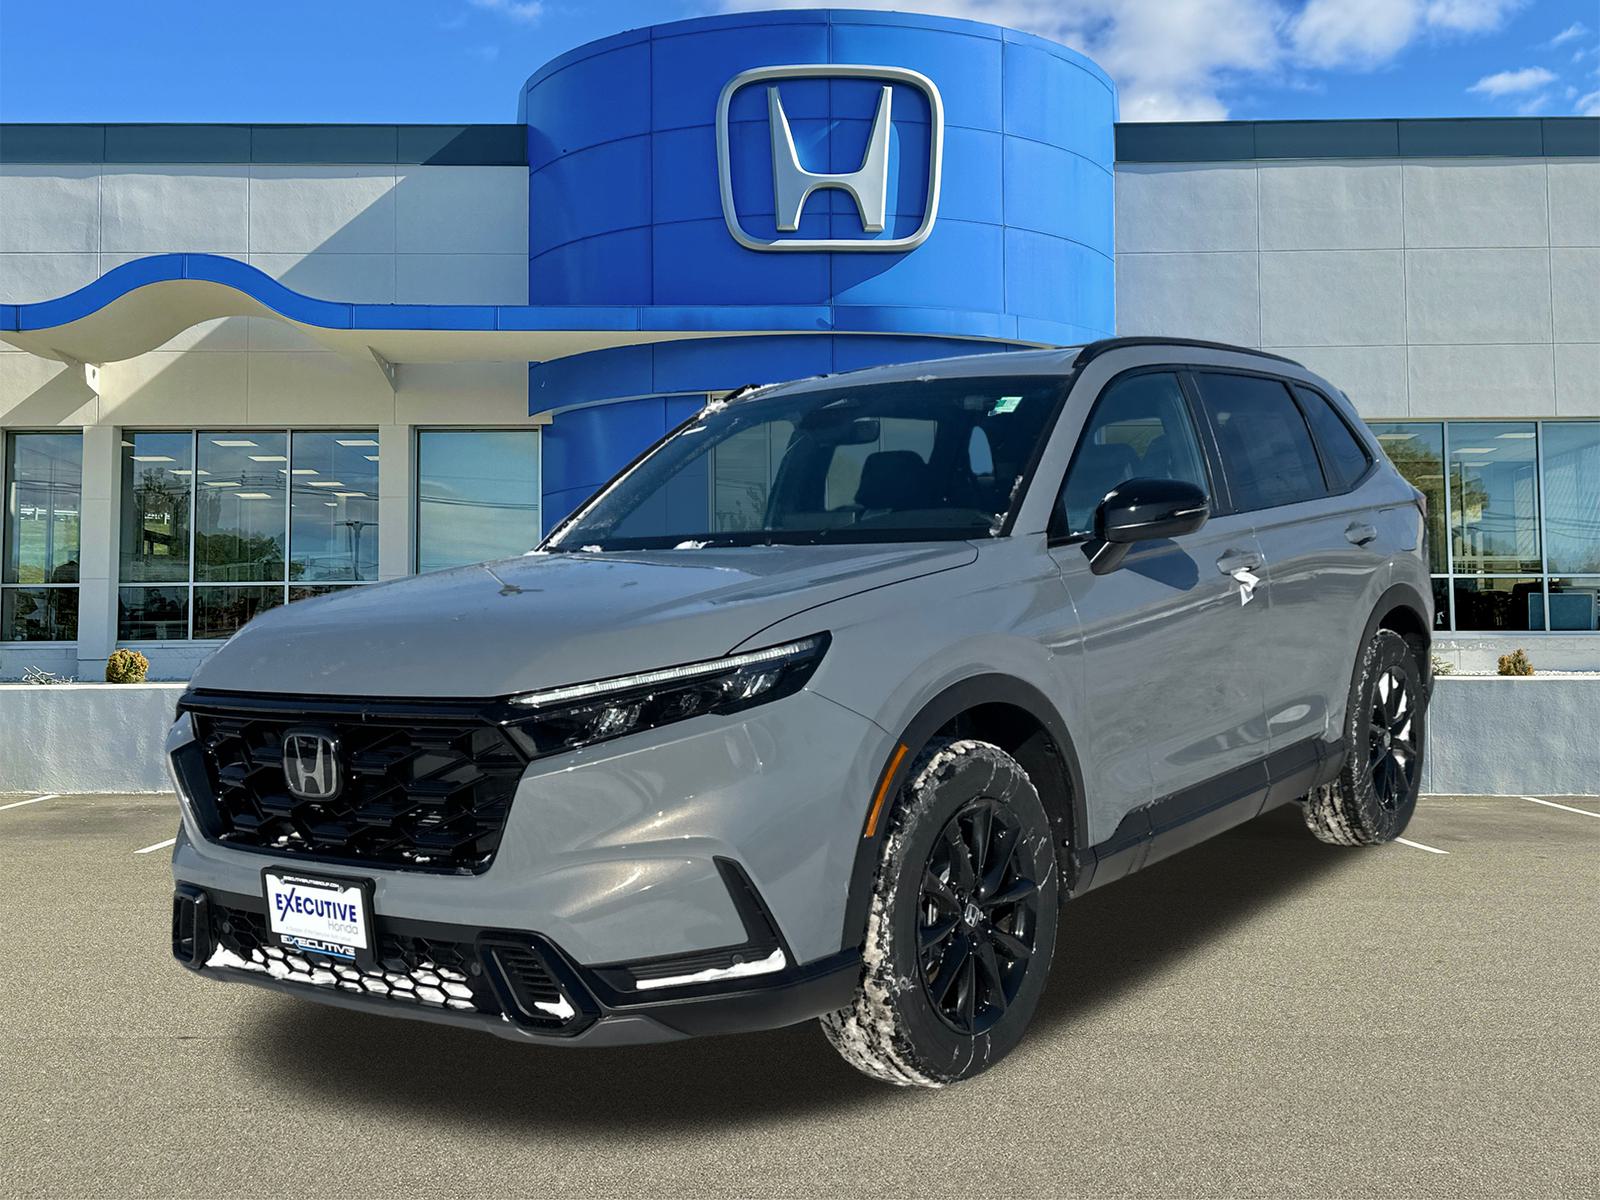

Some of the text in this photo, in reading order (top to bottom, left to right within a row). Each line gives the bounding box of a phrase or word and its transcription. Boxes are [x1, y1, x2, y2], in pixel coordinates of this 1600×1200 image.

[275, 888, 357, 923] EXECUTIVE
[327, 920, 359, 935] Honda
[280, 934, 356, 956] EXECUTIVE
